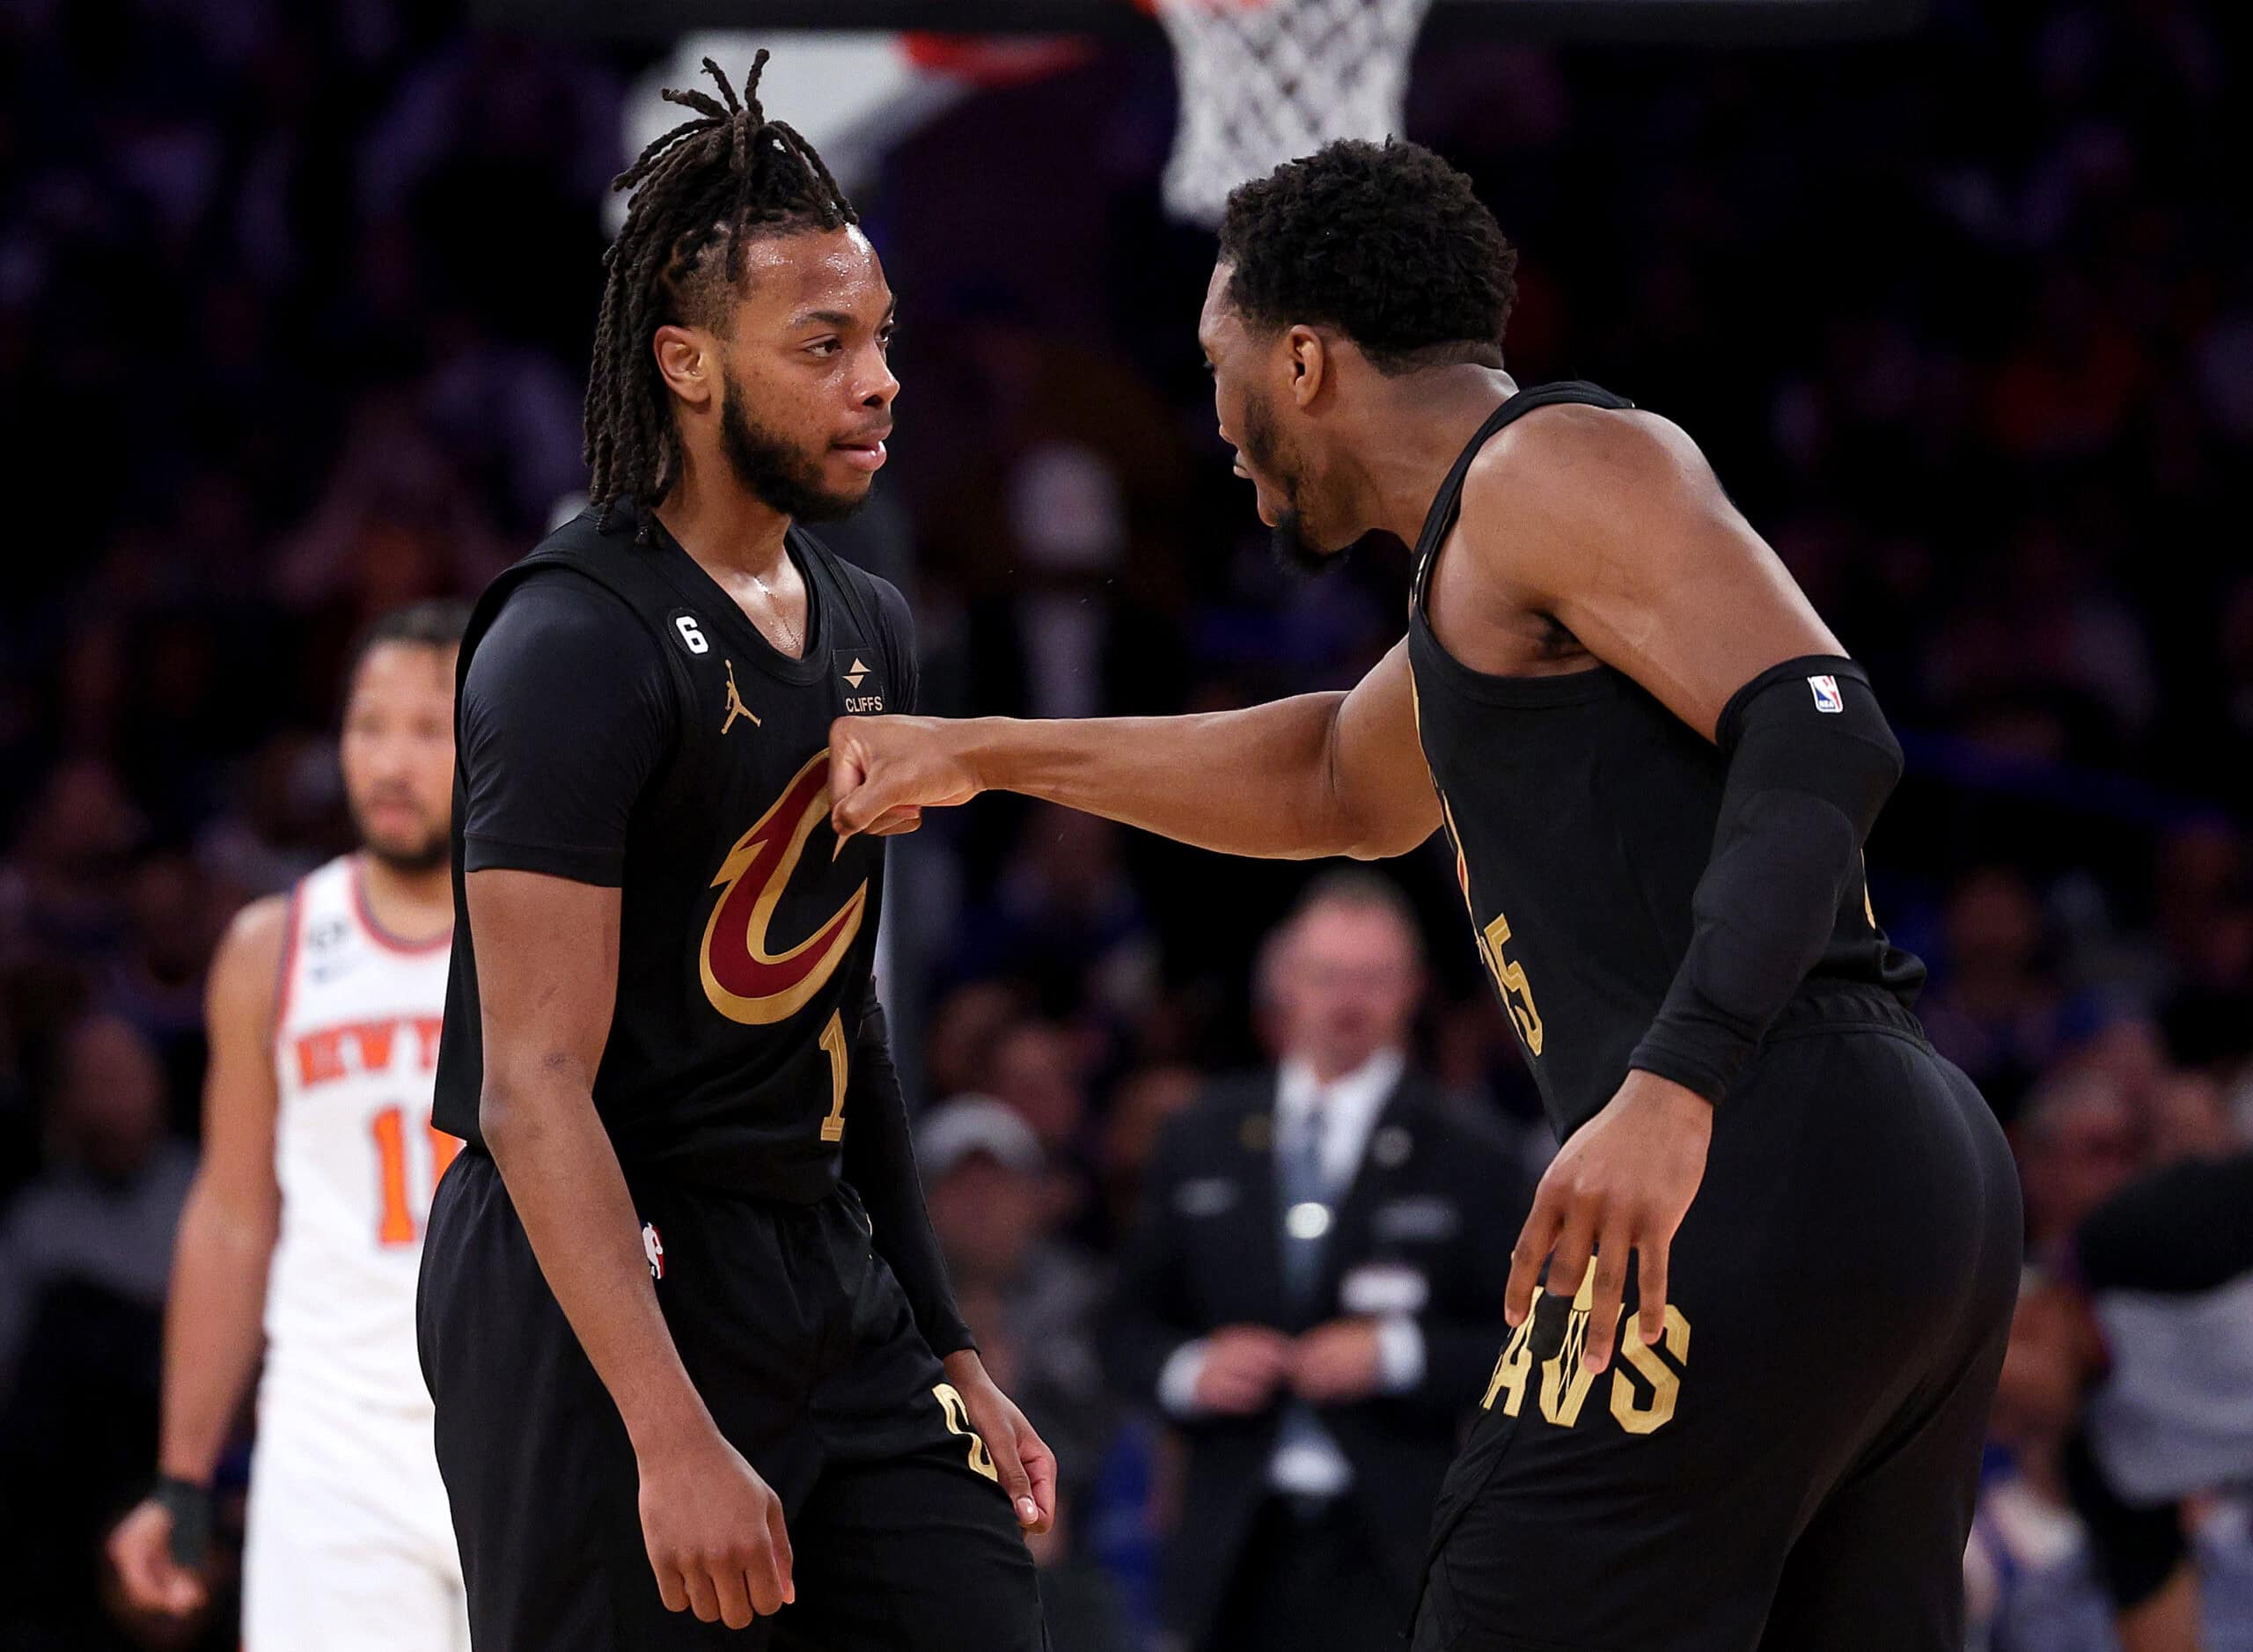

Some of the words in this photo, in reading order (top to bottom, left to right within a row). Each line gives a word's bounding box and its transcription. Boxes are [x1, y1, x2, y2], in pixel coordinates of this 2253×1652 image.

[676, 615, 708, 654] 6
[845, 696, 883, 713] CLIFFS
[1477, 914, 1543, 1057] 5
